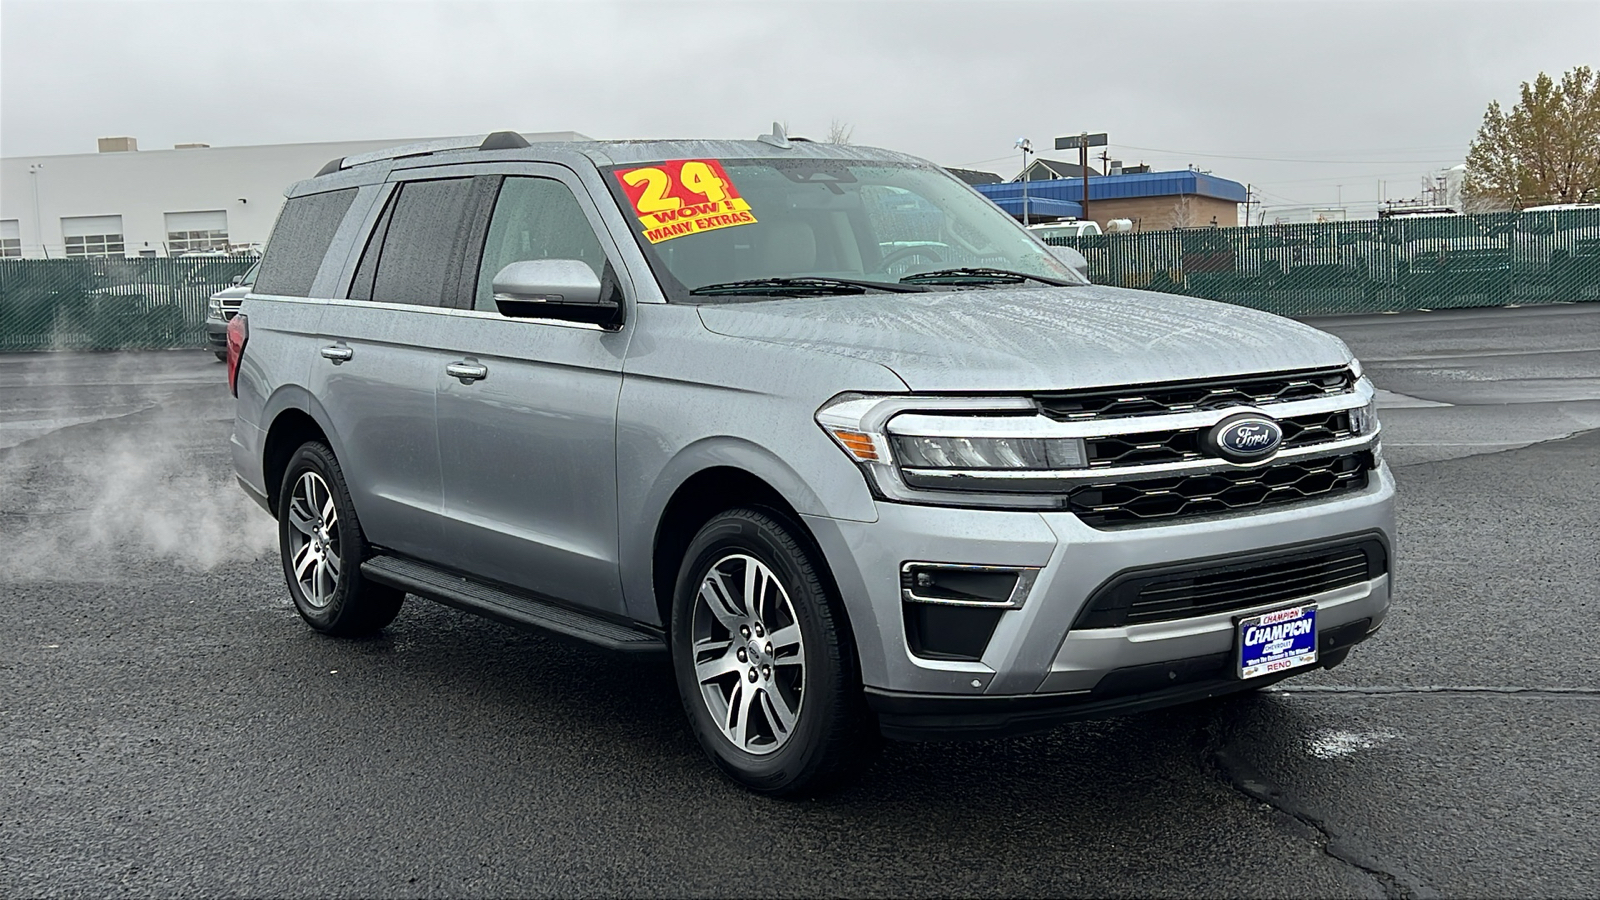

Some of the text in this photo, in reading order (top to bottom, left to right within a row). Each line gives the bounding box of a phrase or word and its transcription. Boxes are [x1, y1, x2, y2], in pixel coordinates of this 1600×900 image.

[623, 161, 730, 213] 24
[647, 211, 753, 242] MANY EXTRAS
[1235, 426, 1270, 448] Ford
[1263, 609, 1299, 625] CHAMPION
[1245, 618, 1313, 647] CHAMPION
[1265, 640, 1292, 652] CHEVROLET
[1267, 660, 1292, 671] RENO
